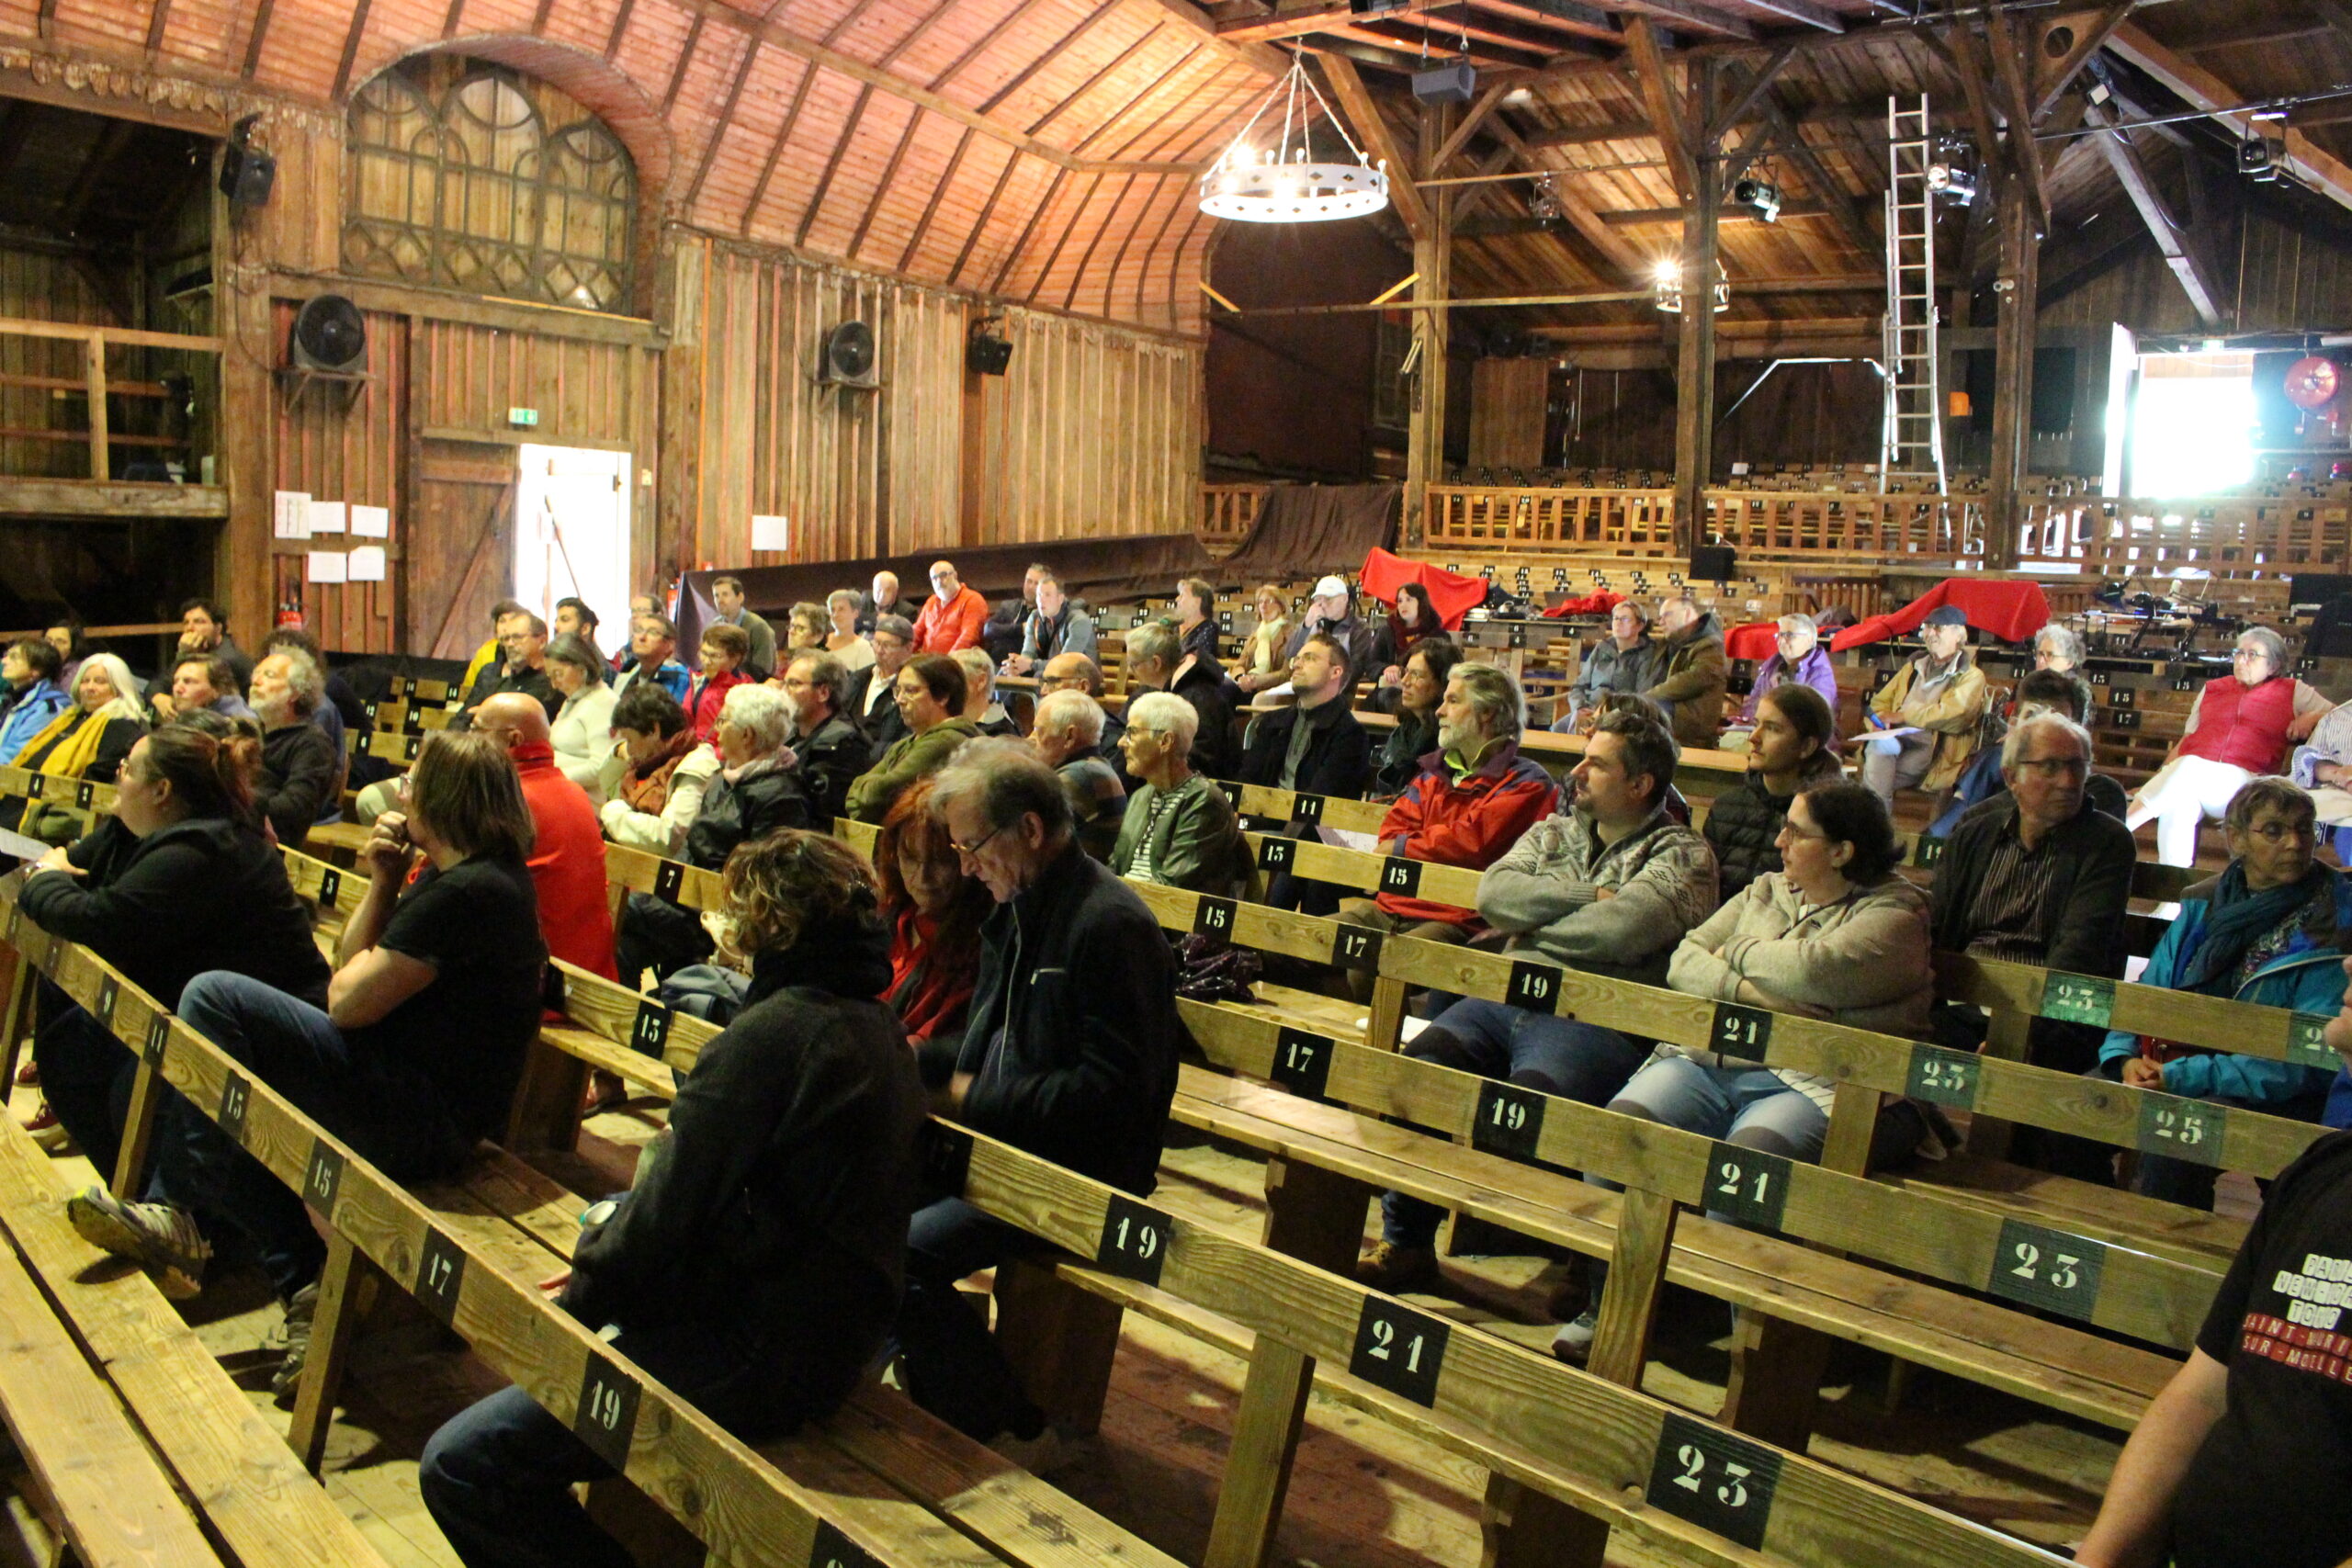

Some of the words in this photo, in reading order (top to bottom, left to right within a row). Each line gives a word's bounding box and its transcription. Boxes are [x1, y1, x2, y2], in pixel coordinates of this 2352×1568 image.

[2301, 660, 2313, 670] 17
[2119, 714, 2132, 724] 17
[1301, 800, 1316, 815] 11
[1268, 846, 1283, 861] 13
[667, 870, 674, 887] 7
[1389, 867, 1407, 885] 15
[1206, 907, 1225, 927] 15
[1346, 935, 1366, 956] 17
[1522, 974, 1547, 998] 19
[2057, 986, 2096, 1012] 23
[104, 991, 111, 1011] 9
[152, 1025, 163, 1053] 11
[641, 1015, 660, 1042] 13
[1724, 1018, 1757, 1043] 21
[1287, 1043, 1313, 1071] 17
[1922, 1062, 1963, 1090] 23
[1493, 1099, 1525, 1129] 19
[2155, 1111, 2202, 1144] 25
[314, 1159, 331, 1197] 15
[1719, 1163, 1768, 1202] 21
[1117, 1217, 1156, 1258] 19
[429, 1254, 451, 1295] 17
[2012, 1243, 2079, 1288] 23
[1369, 1321, 1423, 1372] 21
[591, 1381, 619, 1429] 19
[1673, 1445, 1750, 1507] 23
